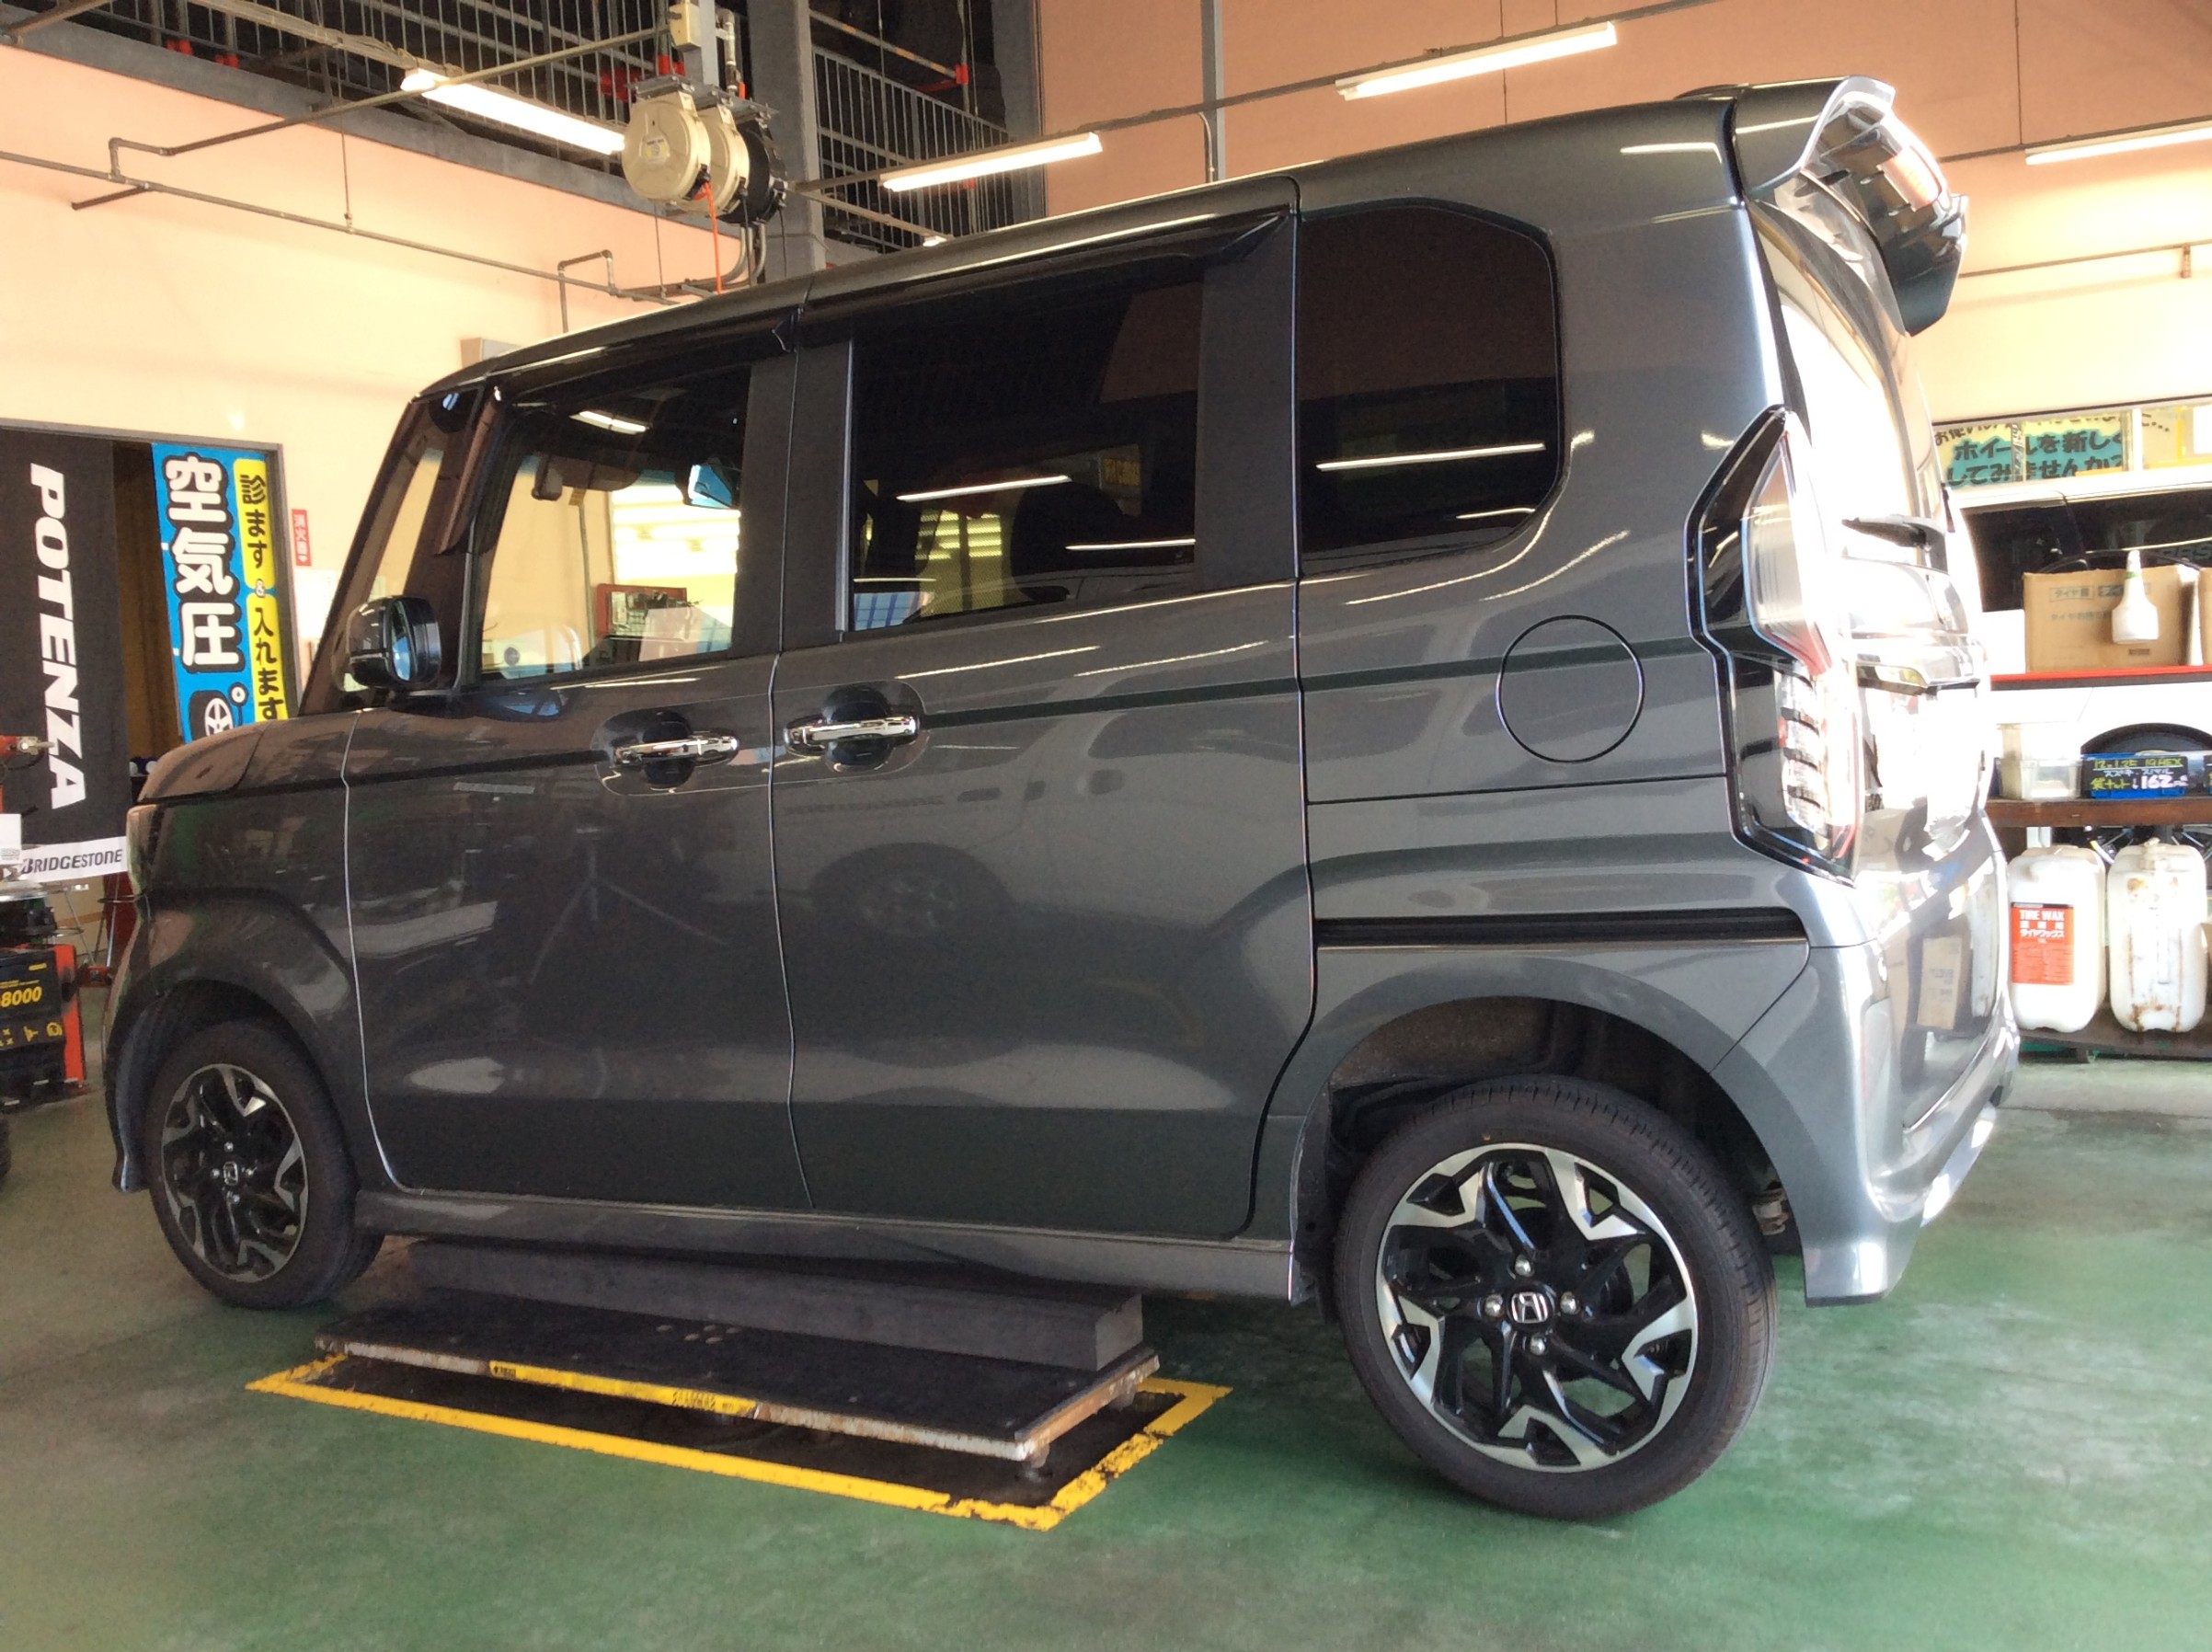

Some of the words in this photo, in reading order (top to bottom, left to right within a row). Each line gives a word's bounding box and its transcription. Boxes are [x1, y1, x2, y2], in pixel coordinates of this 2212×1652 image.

[166, 455, 239, 666] 空気圧
[239, 474, 268, 568] 診ます
[30, 463, 86, 809] POTENZA
[253, 607, 284, 720] 入れます
[21, 848, 123, 875] BRIDGESTONE
[2042, 910, 2065, 922] WAX
